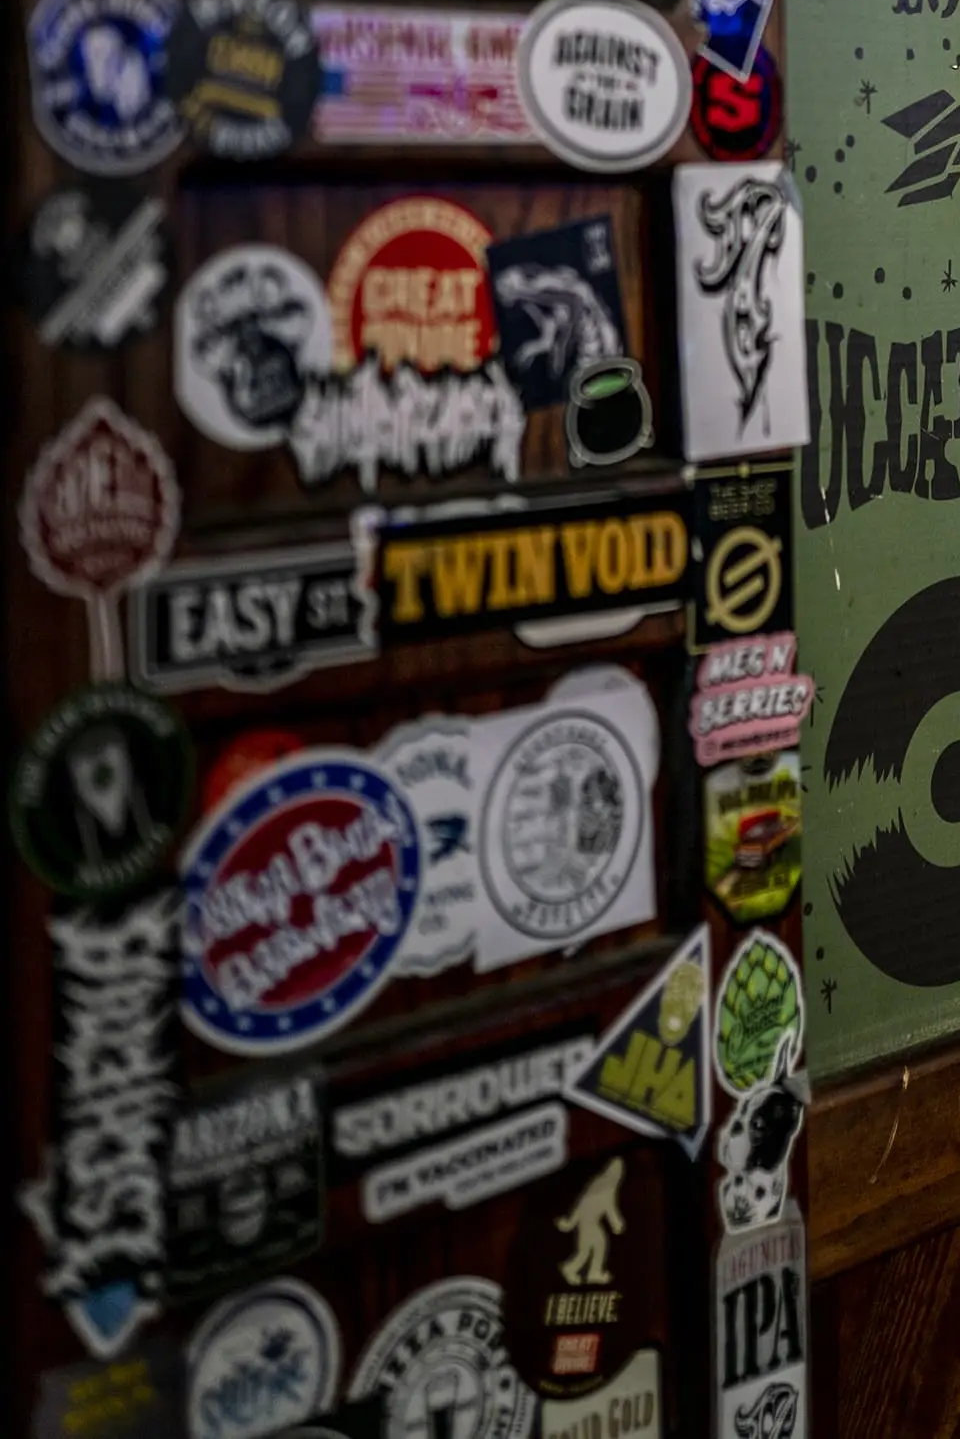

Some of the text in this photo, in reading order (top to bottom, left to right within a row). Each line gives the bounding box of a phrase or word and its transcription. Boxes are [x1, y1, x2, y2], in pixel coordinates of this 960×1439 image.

[555, 33, 660, 88] AGAINST
[563, 87, 645, 132] GRAIN
[383, 510, 689, 624] TWIN VOID
[169, 580, 301, 662] EASY
[415, 1116, 559, 1188] VACCINATED
[545, 1293, 553, 1325] I
[721, 1266, 803, 1390] IPA
[608, 1390, 655, 1439] GOLD
